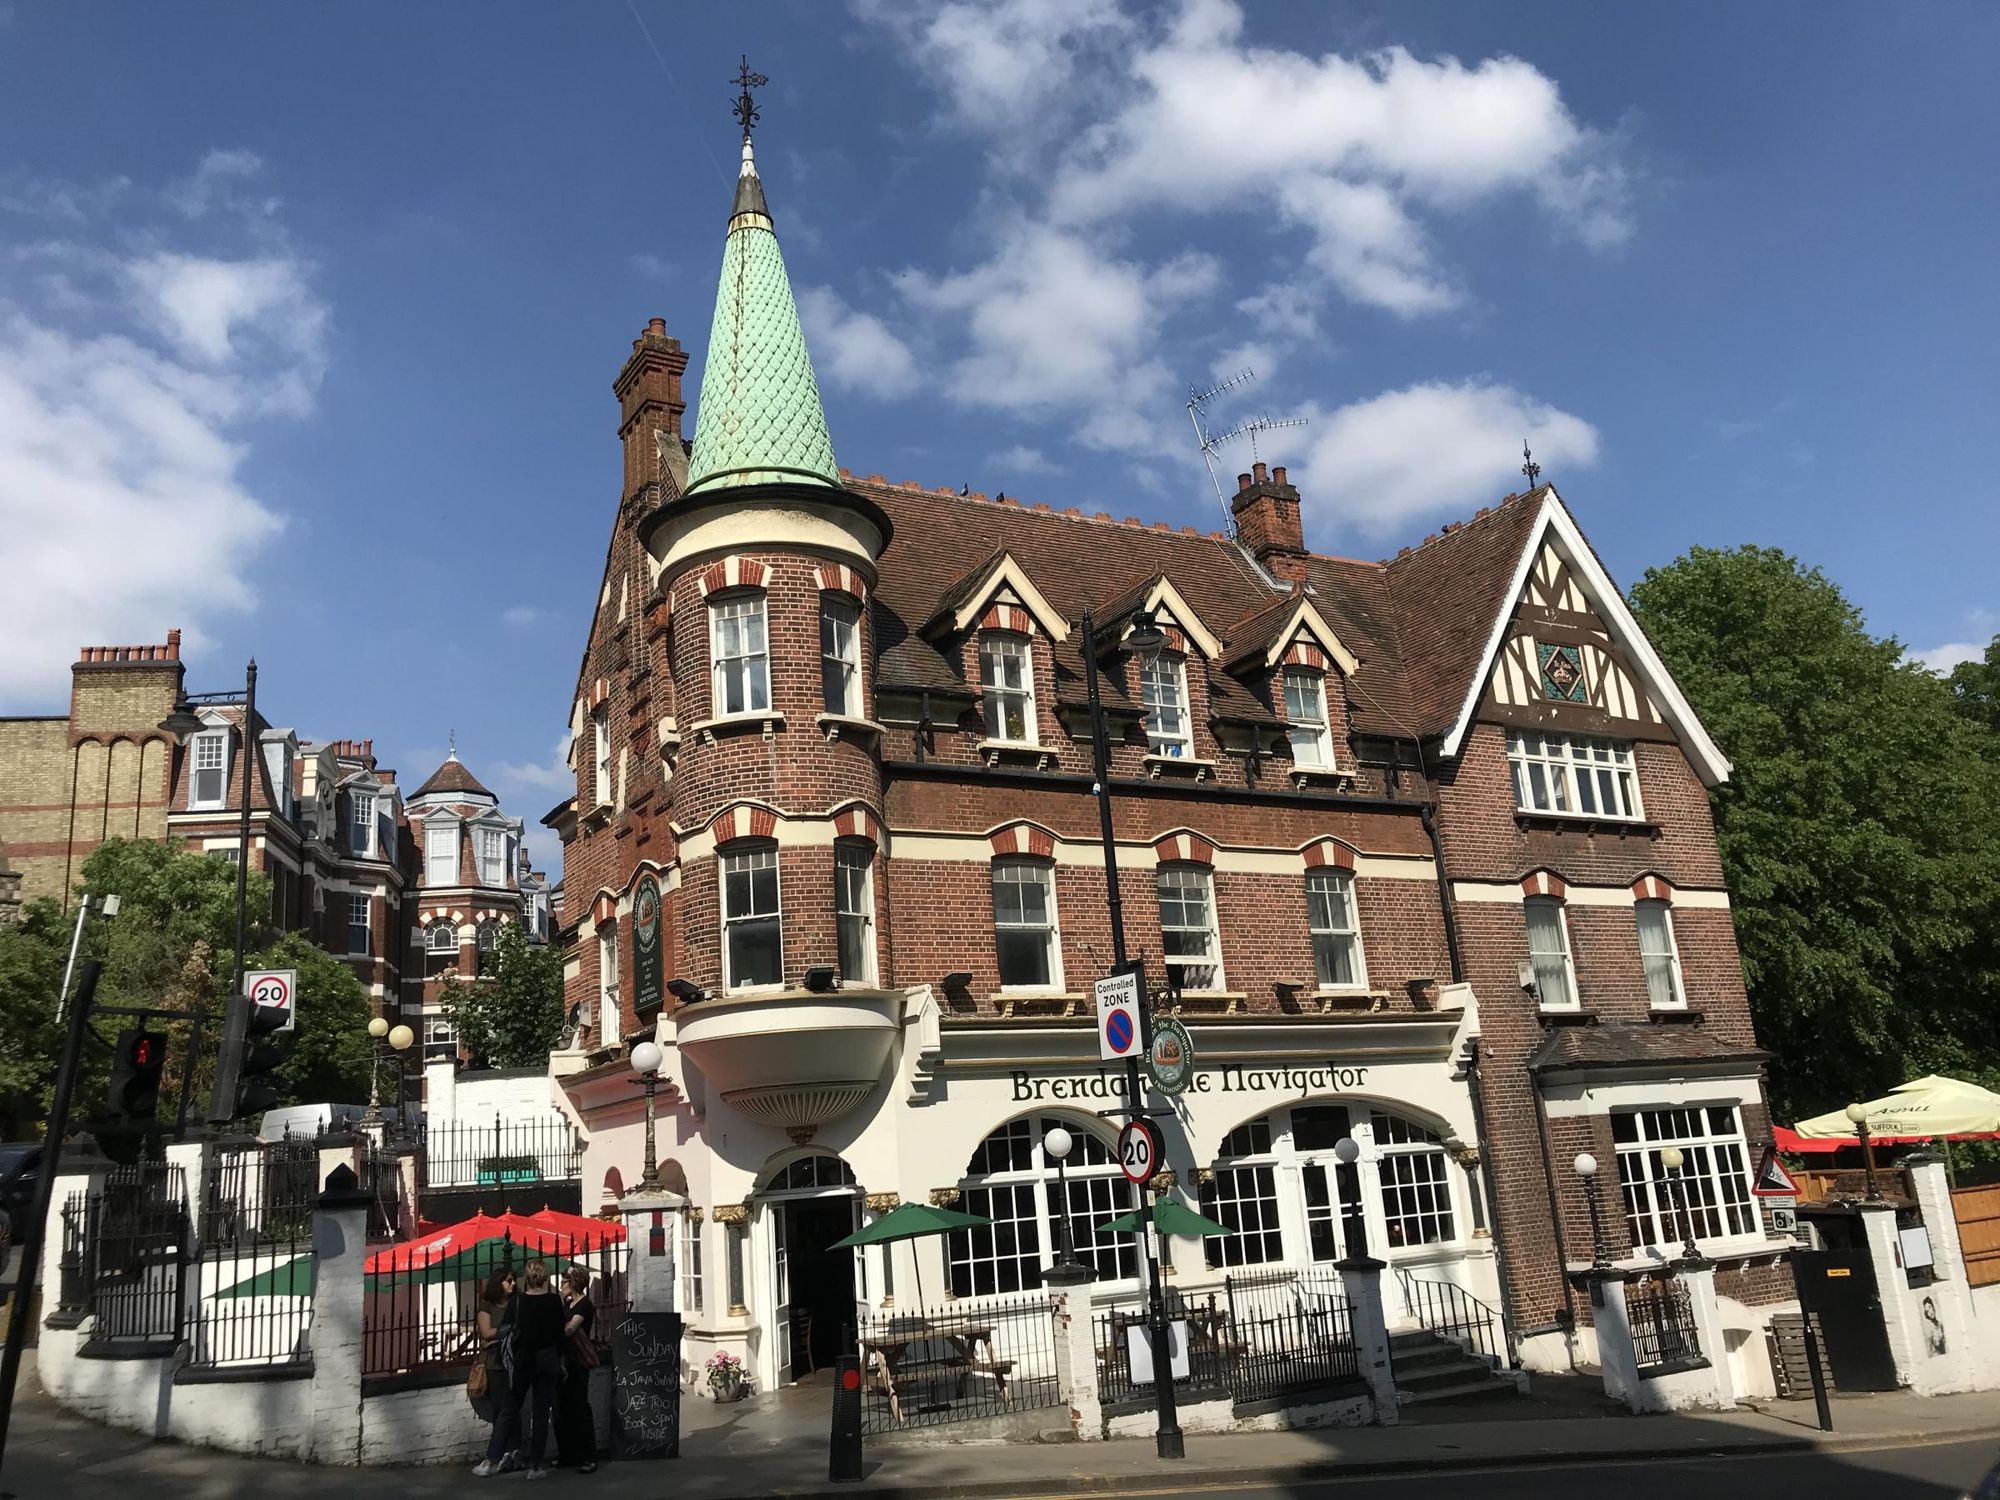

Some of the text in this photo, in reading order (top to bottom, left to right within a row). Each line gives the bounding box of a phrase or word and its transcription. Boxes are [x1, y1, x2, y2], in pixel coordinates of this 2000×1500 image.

[1097, 978, 1134, 993] Controlled
[258, 987, 282, 1001] 20
[1104, 992, 1129, 1007] ZONE
[1221, 1060, 1368, 1098] Navigator
[1871, 1123, 1899, 1131] SUFFOLK
[1123, 1139, 1148, 1165] 20
[1765, 1168, 1783, 1182] 10%
[616, 1318, 646, 1336] THIS
[628, 1334, 678, 1366] SUNDAY
[648, 1394, 671, 1410] TRIO
